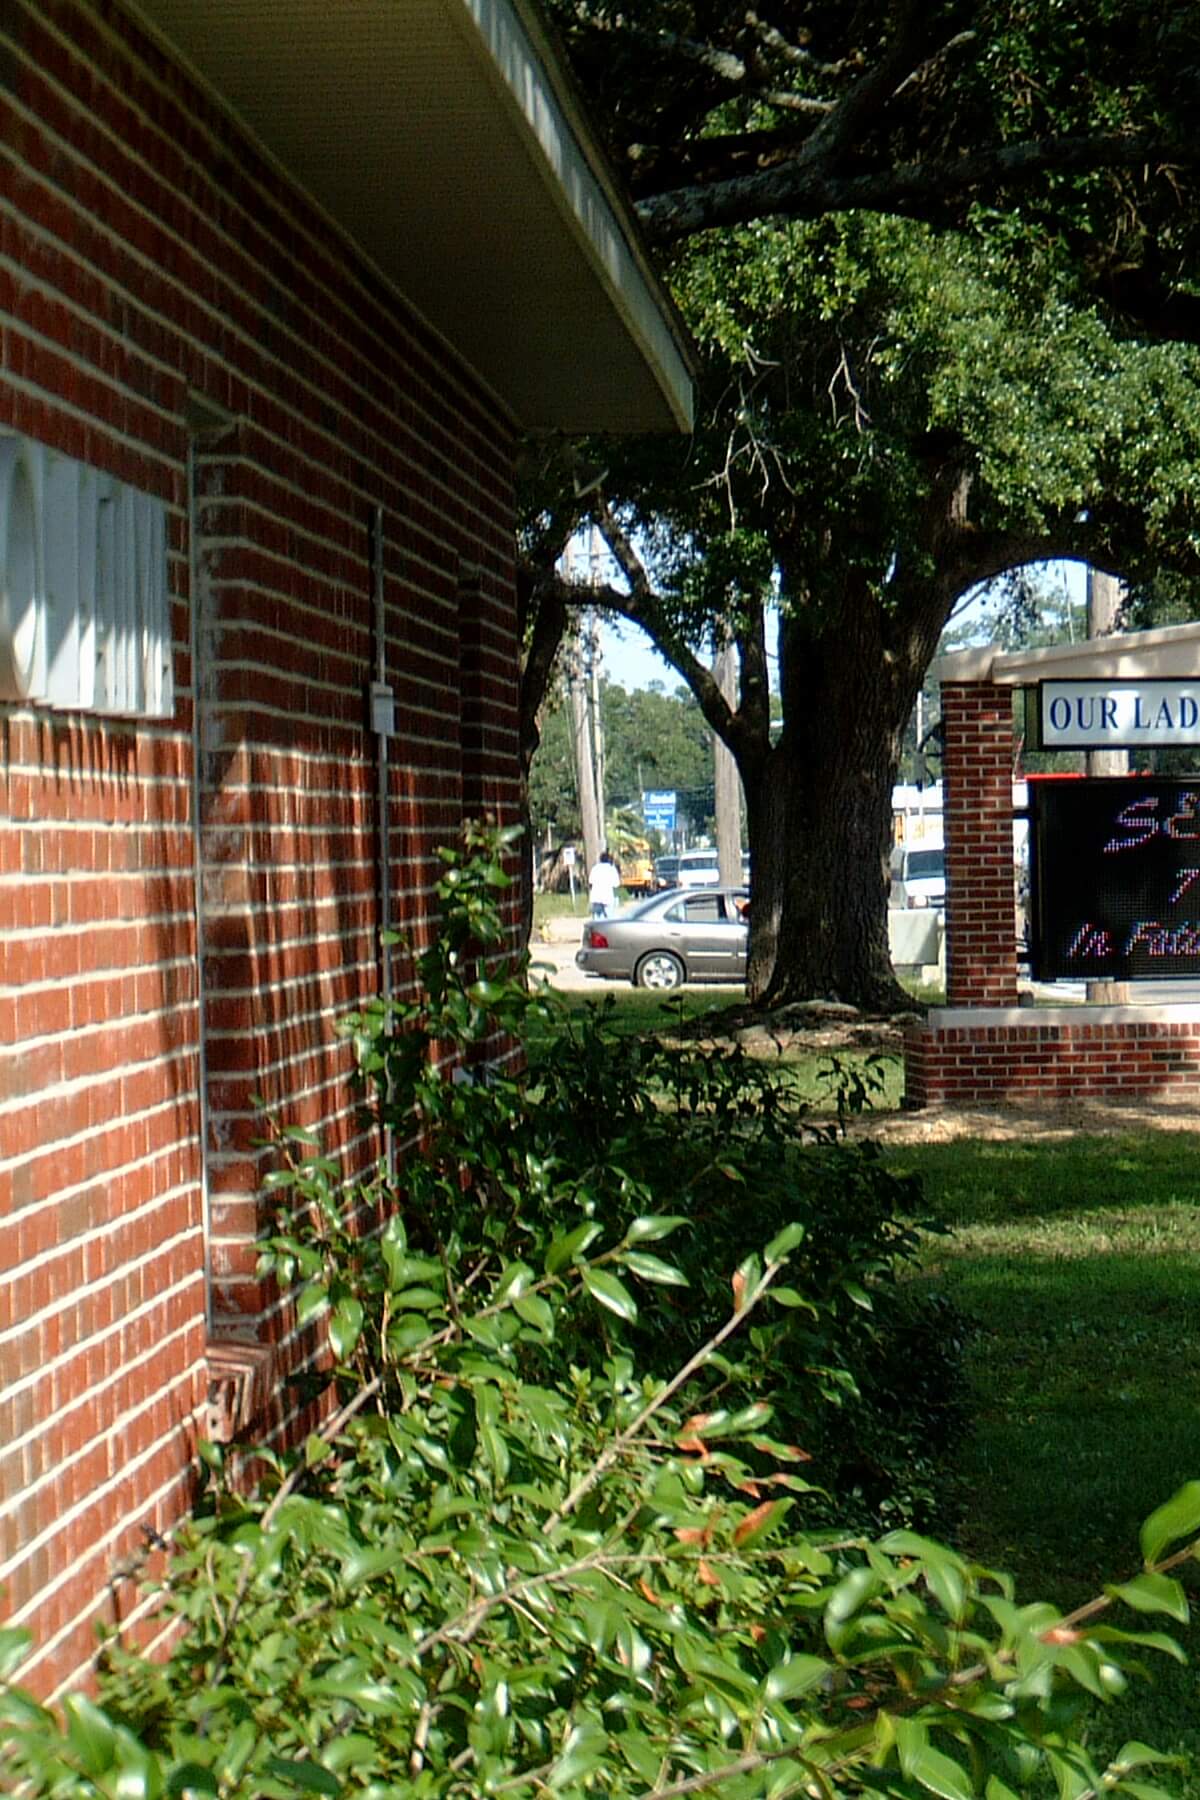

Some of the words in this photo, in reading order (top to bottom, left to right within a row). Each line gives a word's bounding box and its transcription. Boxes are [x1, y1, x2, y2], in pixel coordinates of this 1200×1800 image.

[1049, 696, 1119, 731] OUR
[1168, 867, 1200, 905] 7
[1066, 922, 1112, 957] In
